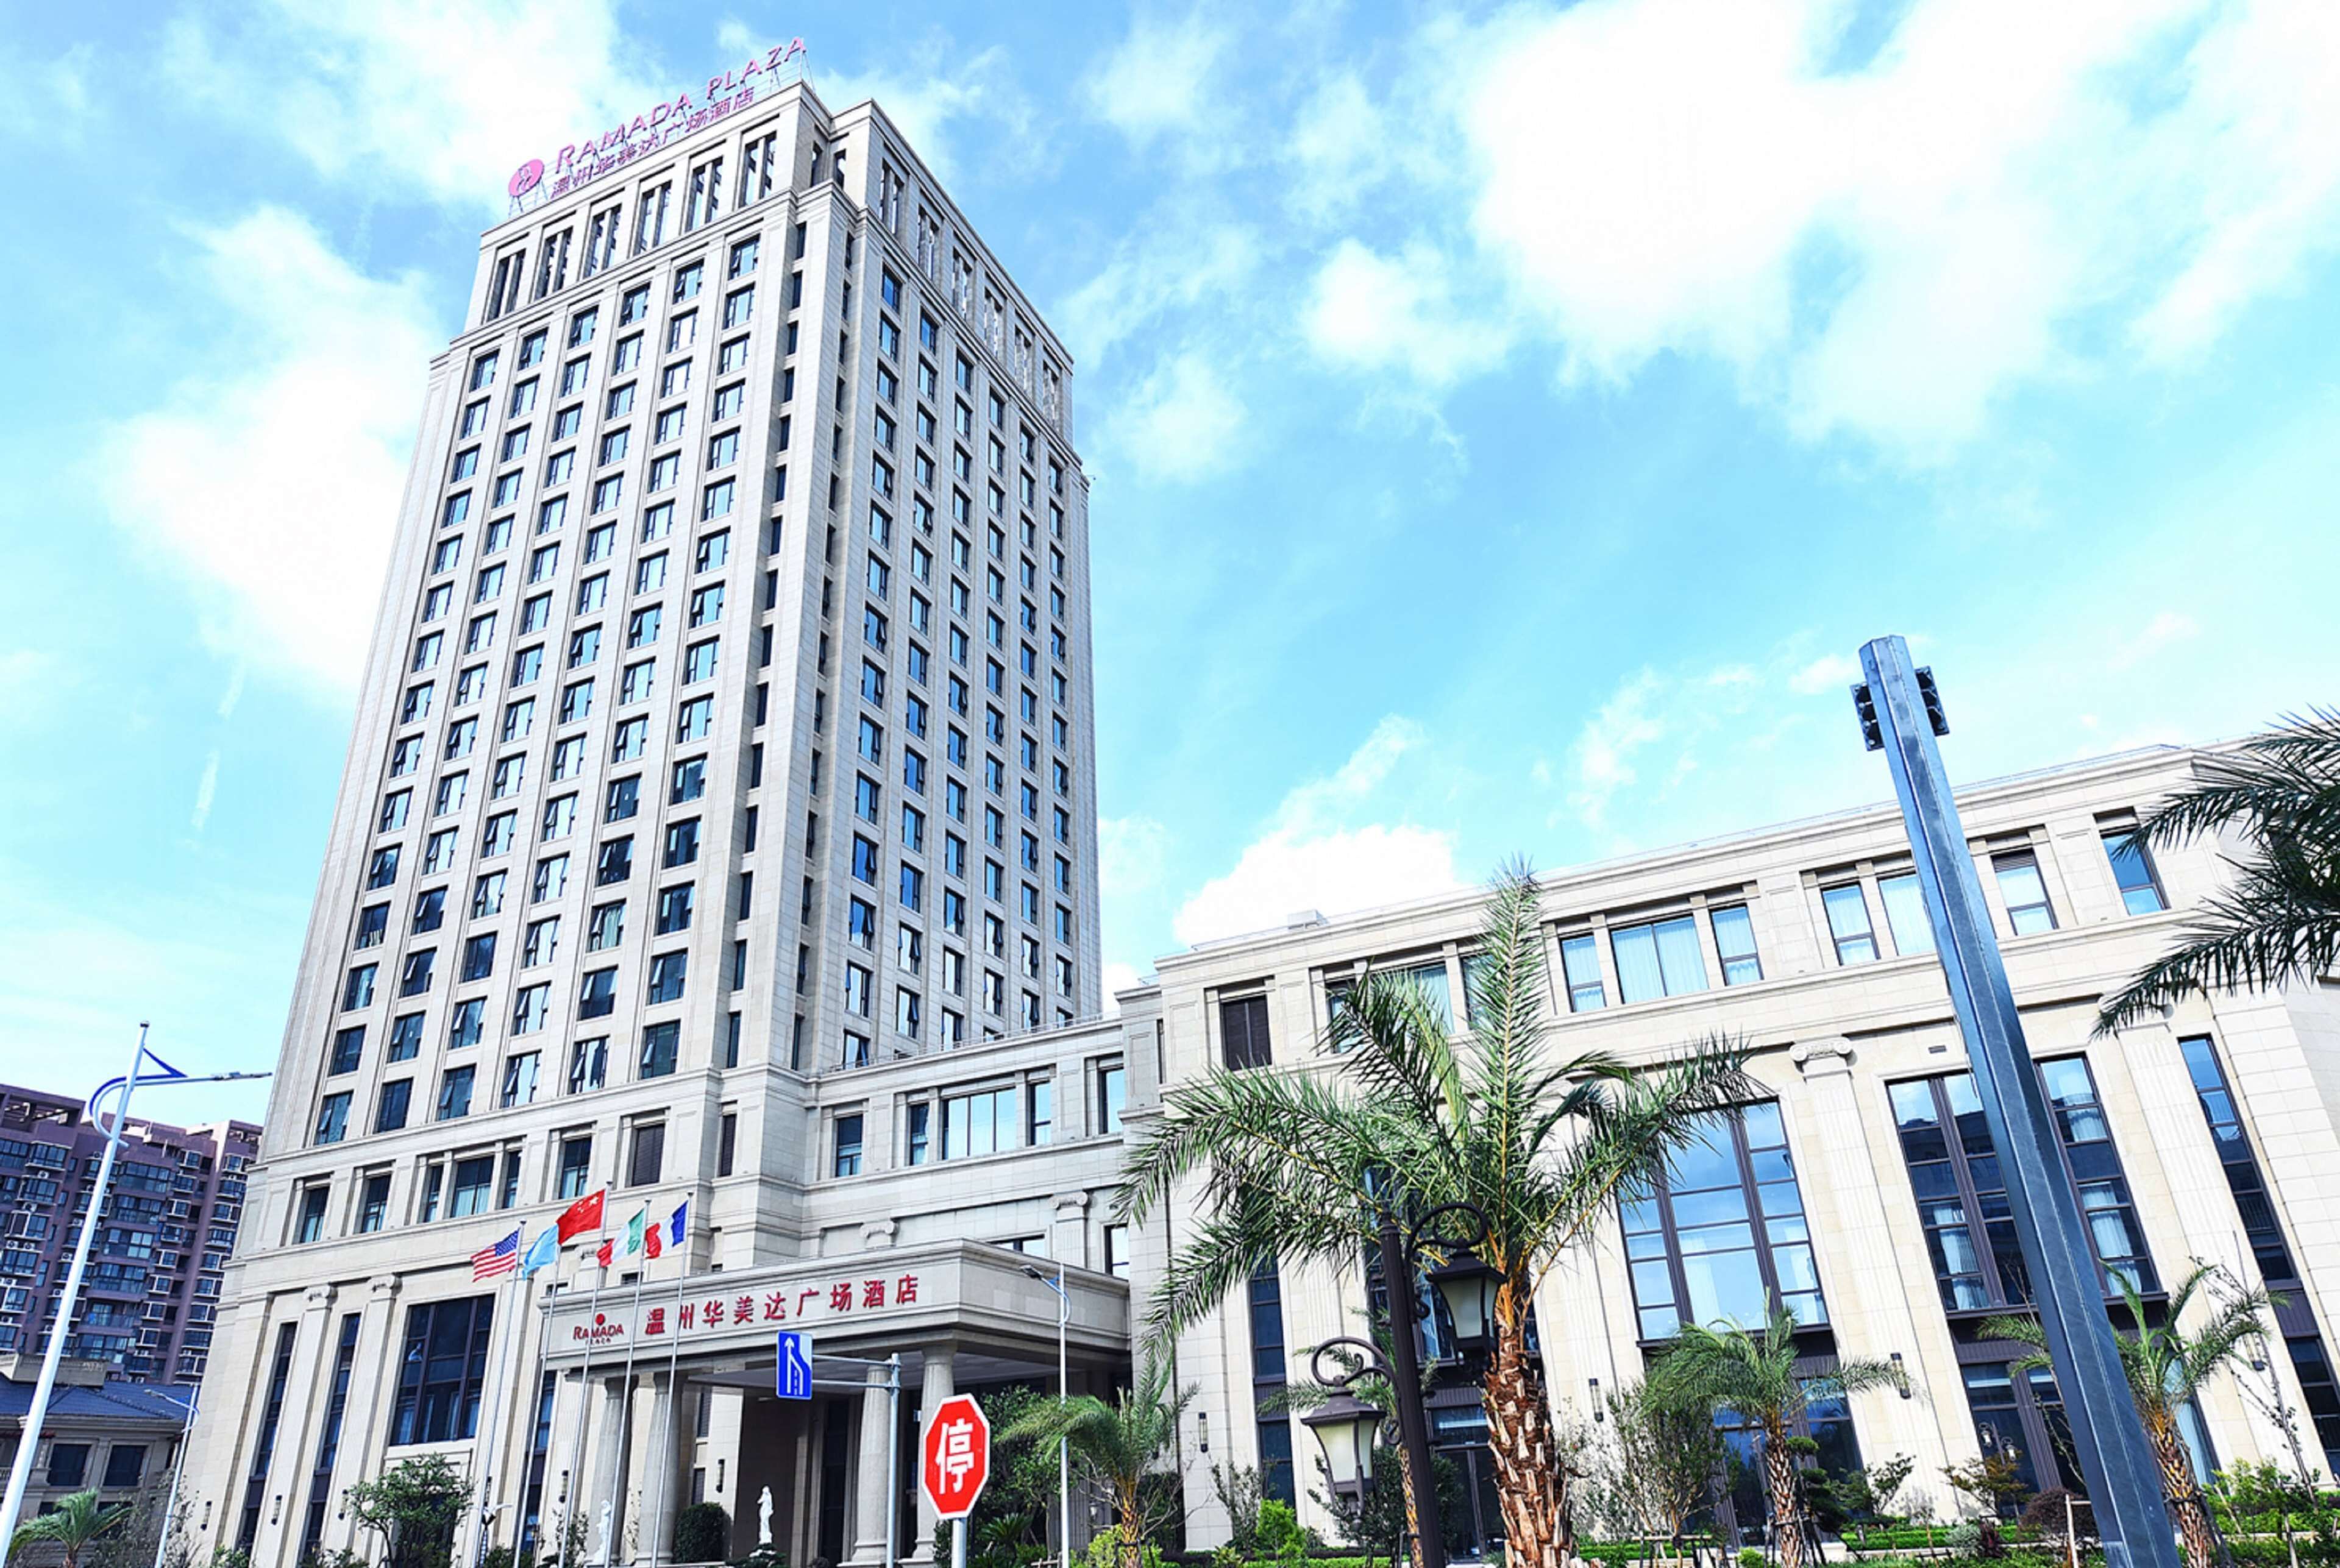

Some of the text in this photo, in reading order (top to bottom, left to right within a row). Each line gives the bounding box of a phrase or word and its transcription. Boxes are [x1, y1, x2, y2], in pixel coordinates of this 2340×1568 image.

[555, 37, 806, 174] RAMADA PLAZA
[573, 1323, 624, 1340] RAMADA
[645, 1274, 919, 1335] 温州华美达广场酒店
[934, 1417, 975, 1495] 停
